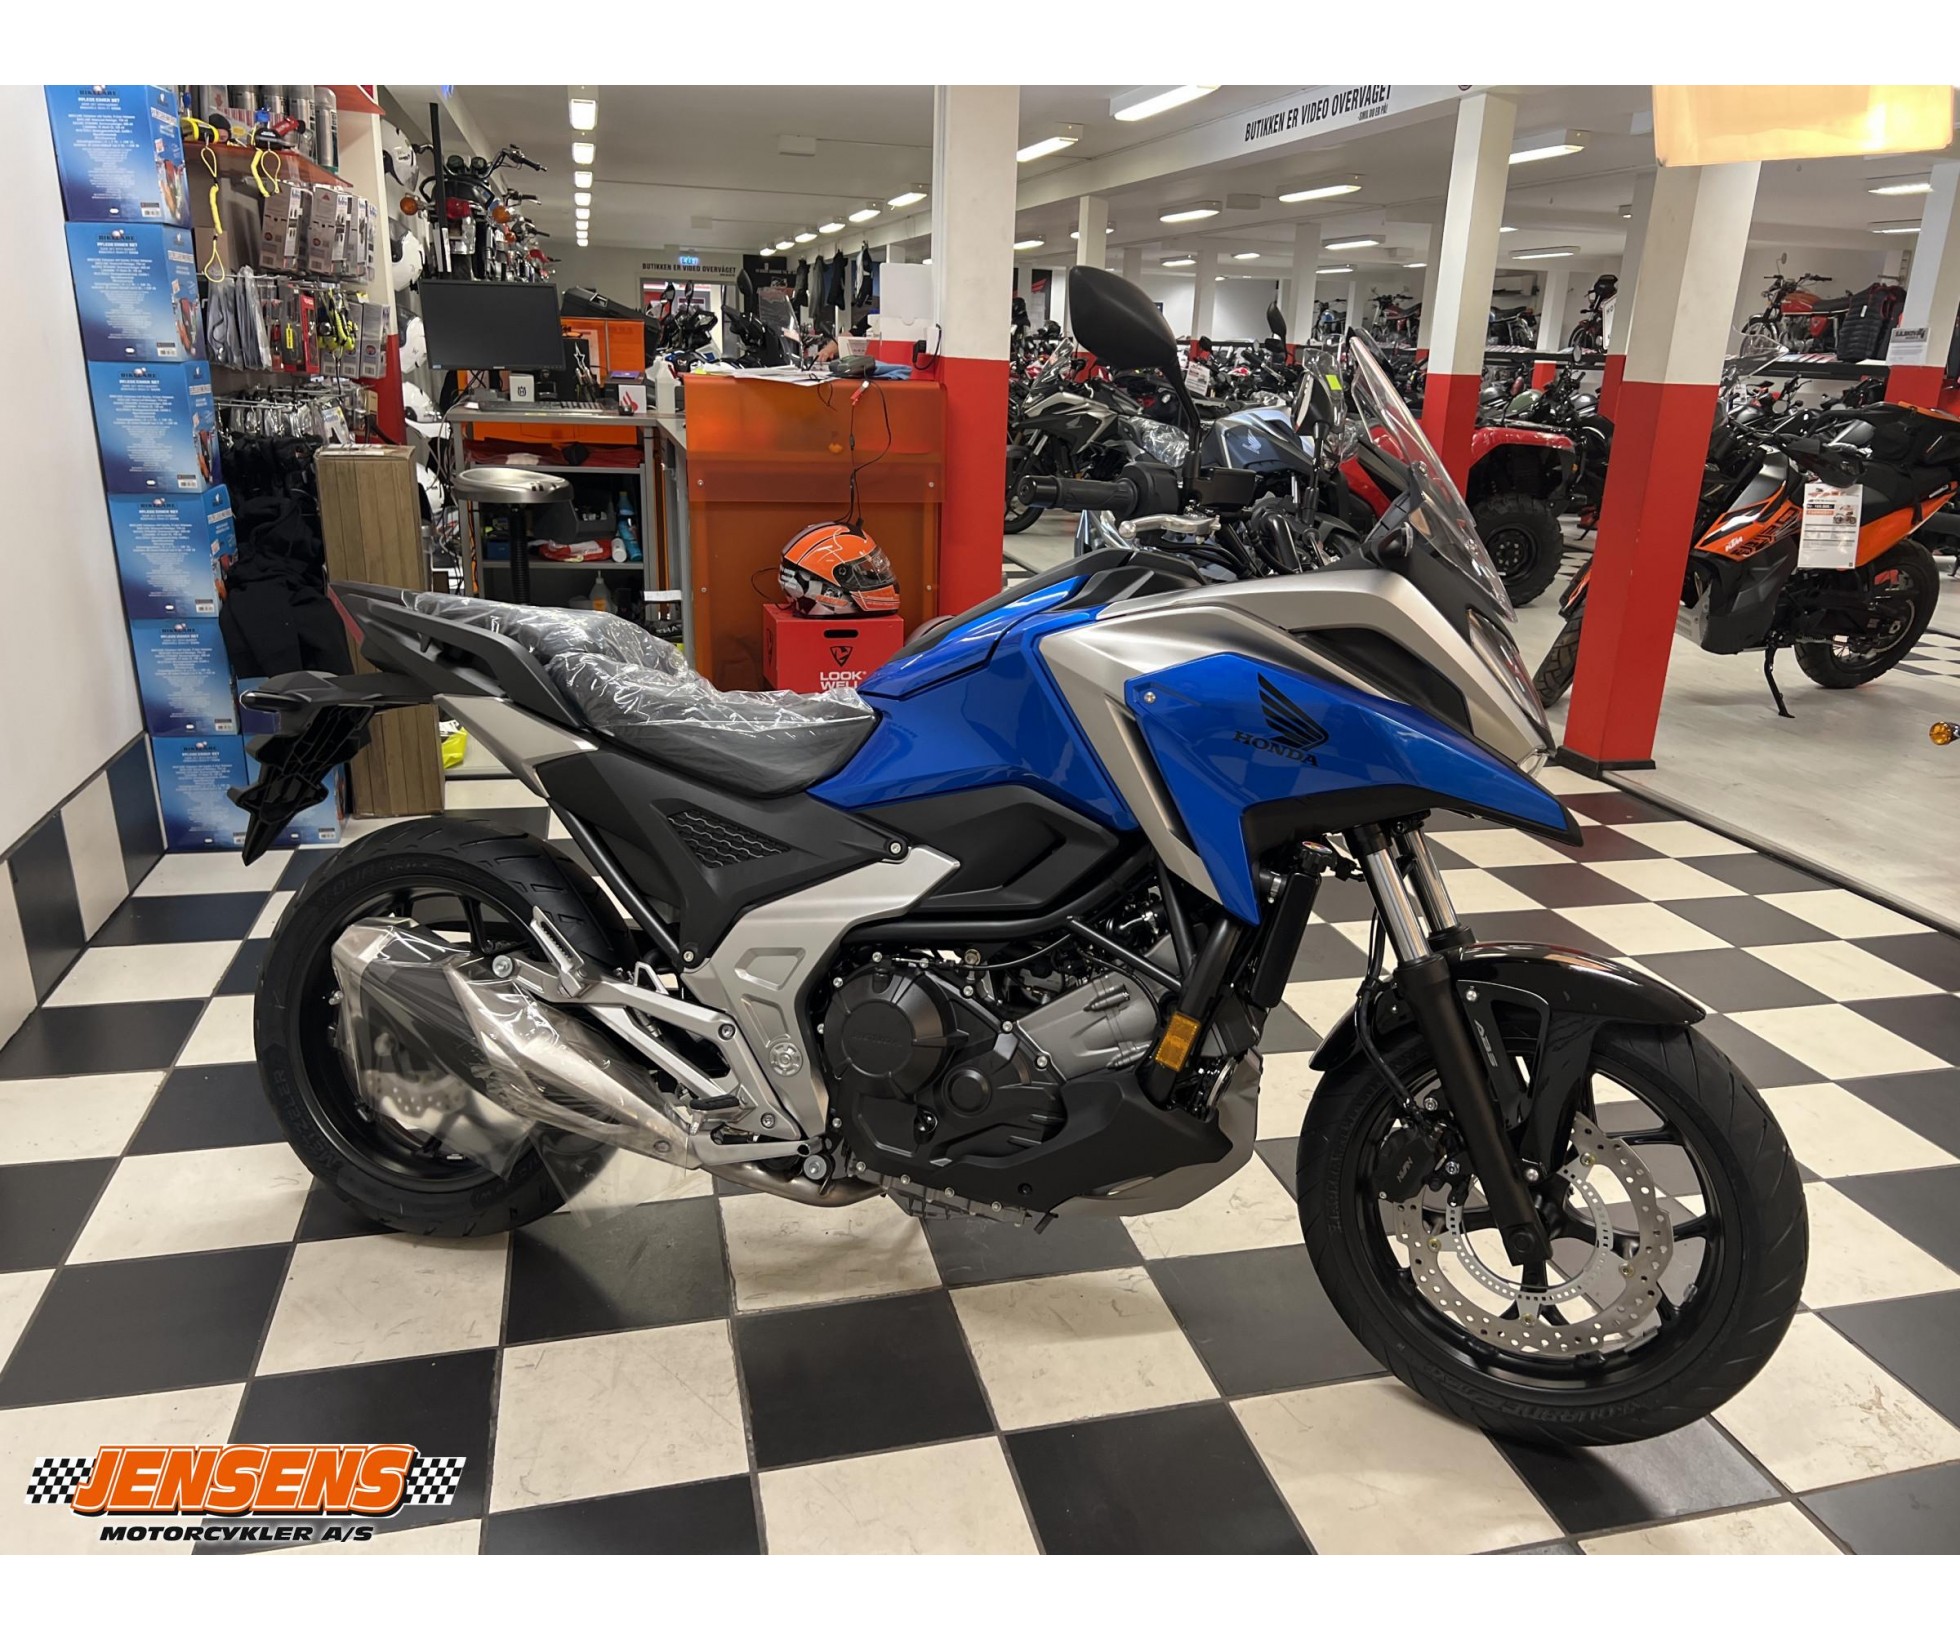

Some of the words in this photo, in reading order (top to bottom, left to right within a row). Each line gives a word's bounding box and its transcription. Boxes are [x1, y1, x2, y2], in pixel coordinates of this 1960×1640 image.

[1244, 111, 1286, 142] BUTIKKEN
[1286, 107, 1299, 130] ER
[1301, 98, 1329, 126] VIDEO
[1725, 536, 1743, 552] KTM
[820, 671, 862, 680] LOOK
[1232, 730, 1318, 767] HONDA
[1474, 1018, 1498, 1067] ABS
